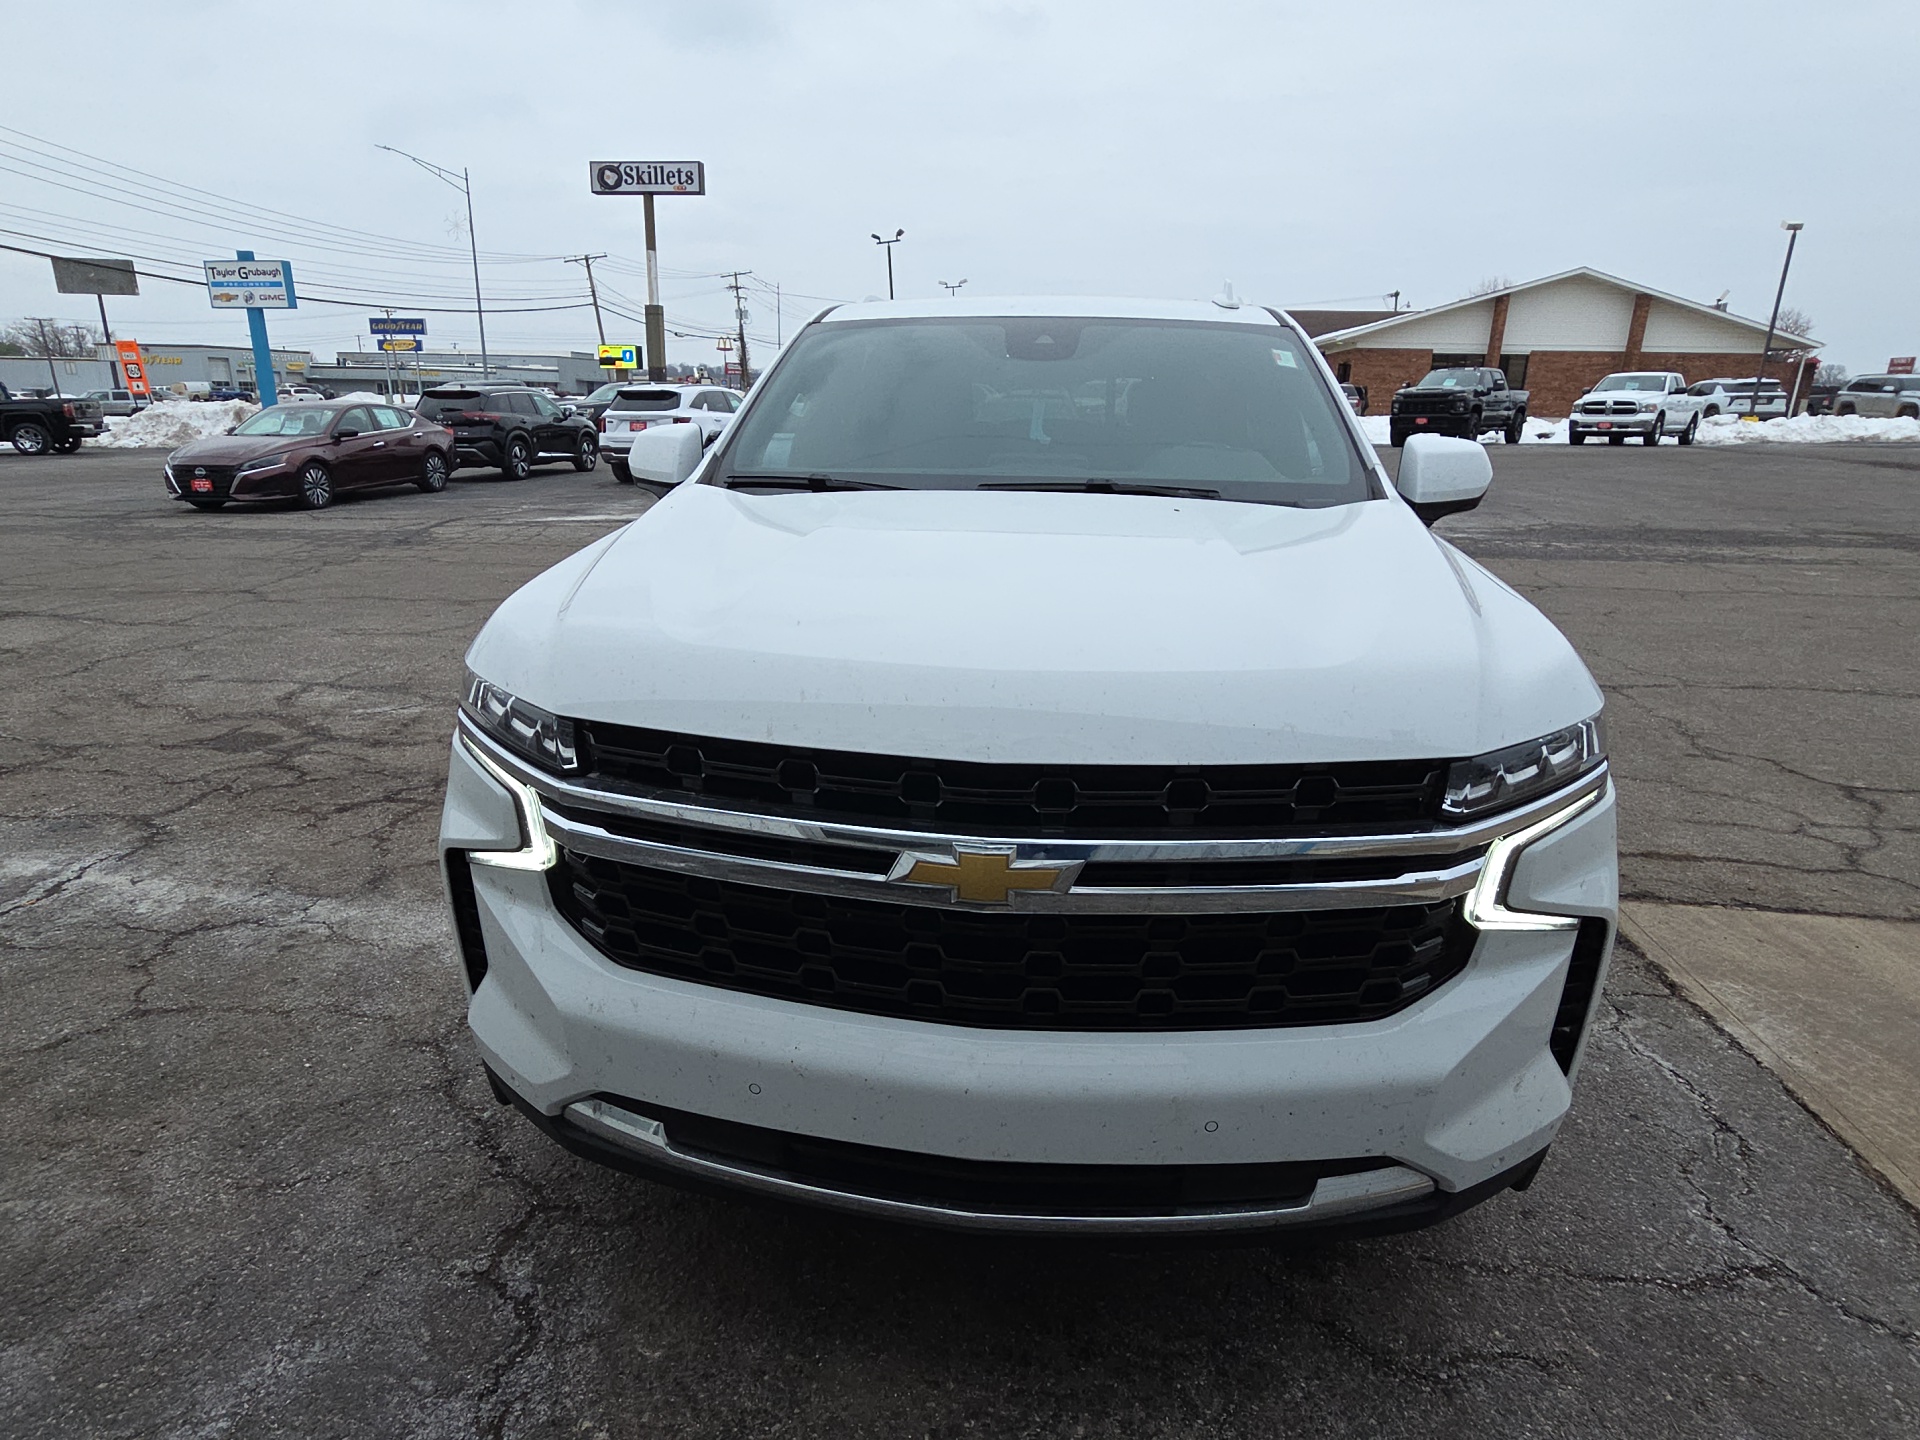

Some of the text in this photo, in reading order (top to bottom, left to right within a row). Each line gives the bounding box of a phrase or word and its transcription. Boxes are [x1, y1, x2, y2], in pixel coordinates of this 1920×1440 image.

[624, 165, 694, 185] Skillets
[208, 267, 281, 280] Taylor Grubaugh
[372, 321, 422, 331] GOODYEAR
[141, 355, 183, 365] DYEAR
